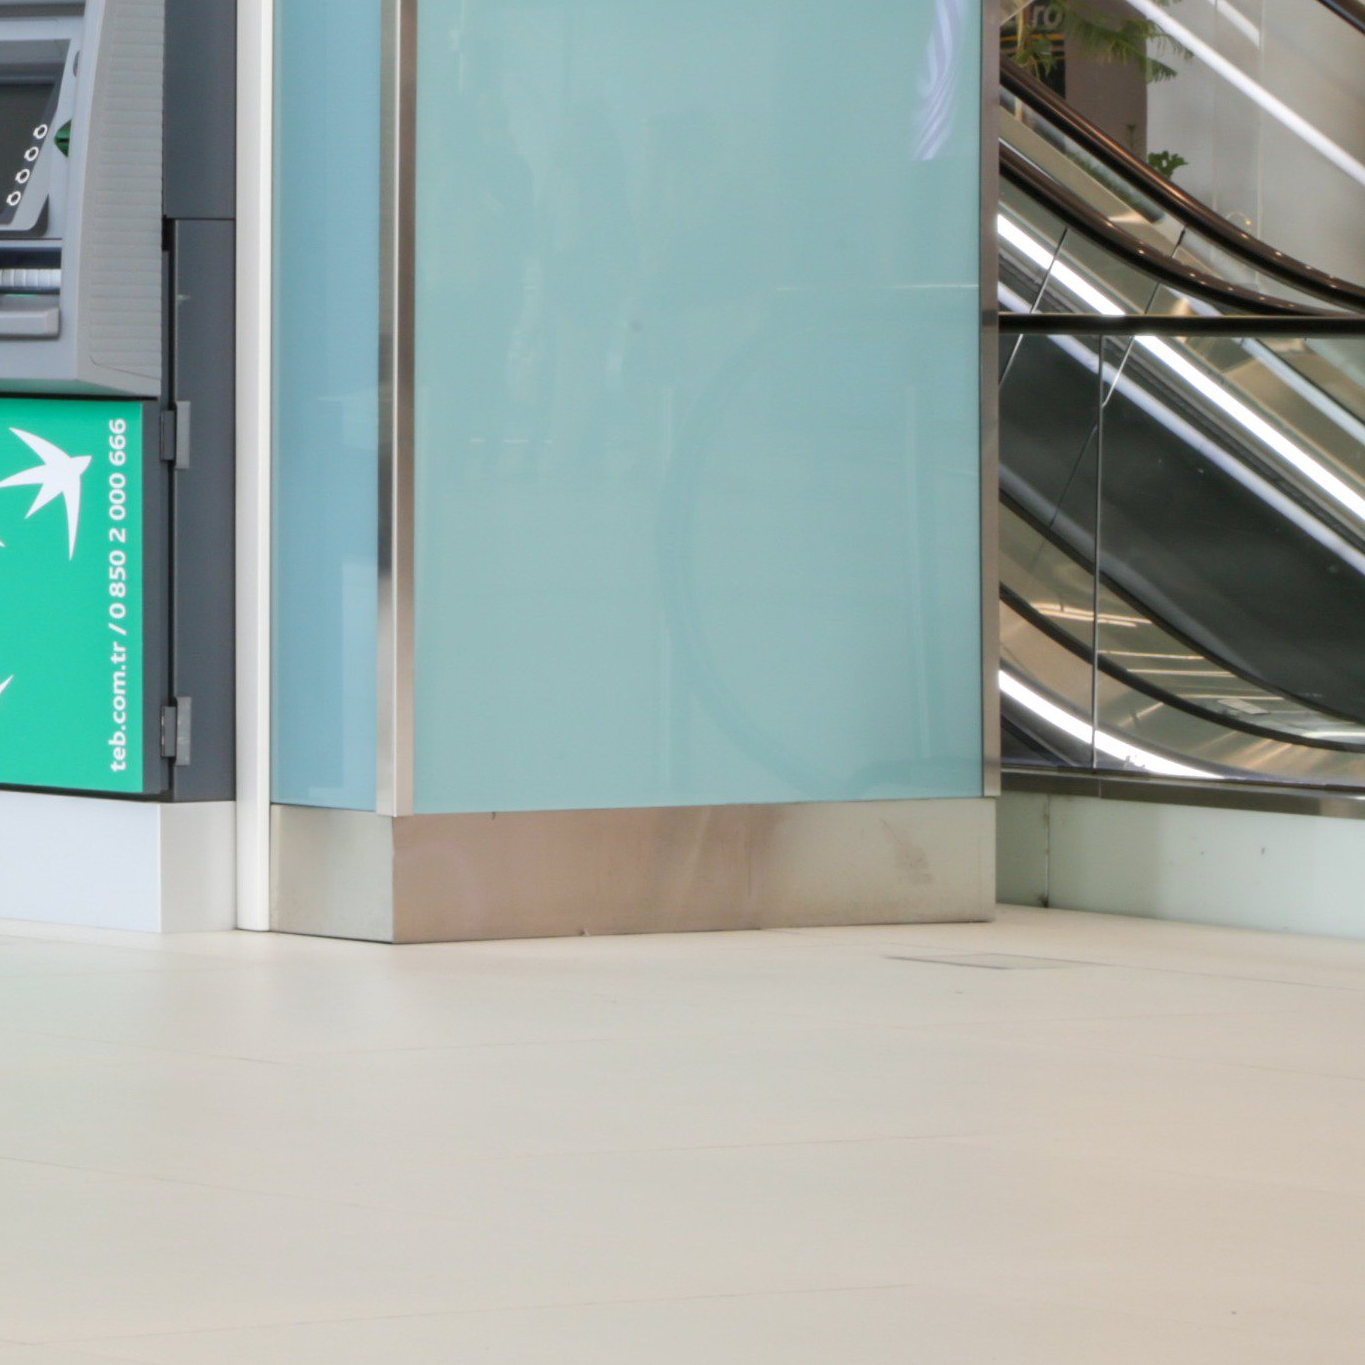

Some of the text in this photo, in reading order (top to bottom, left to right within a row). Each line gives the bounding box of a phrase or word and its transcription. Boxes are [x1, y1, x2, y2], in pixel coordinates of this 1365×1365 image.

[109, 418, 126, 466] 666
[109, 473, 126, 520] 000
[109, 550, 126, 598] 850
[108, 642, 127, 772] teb.com.tr
